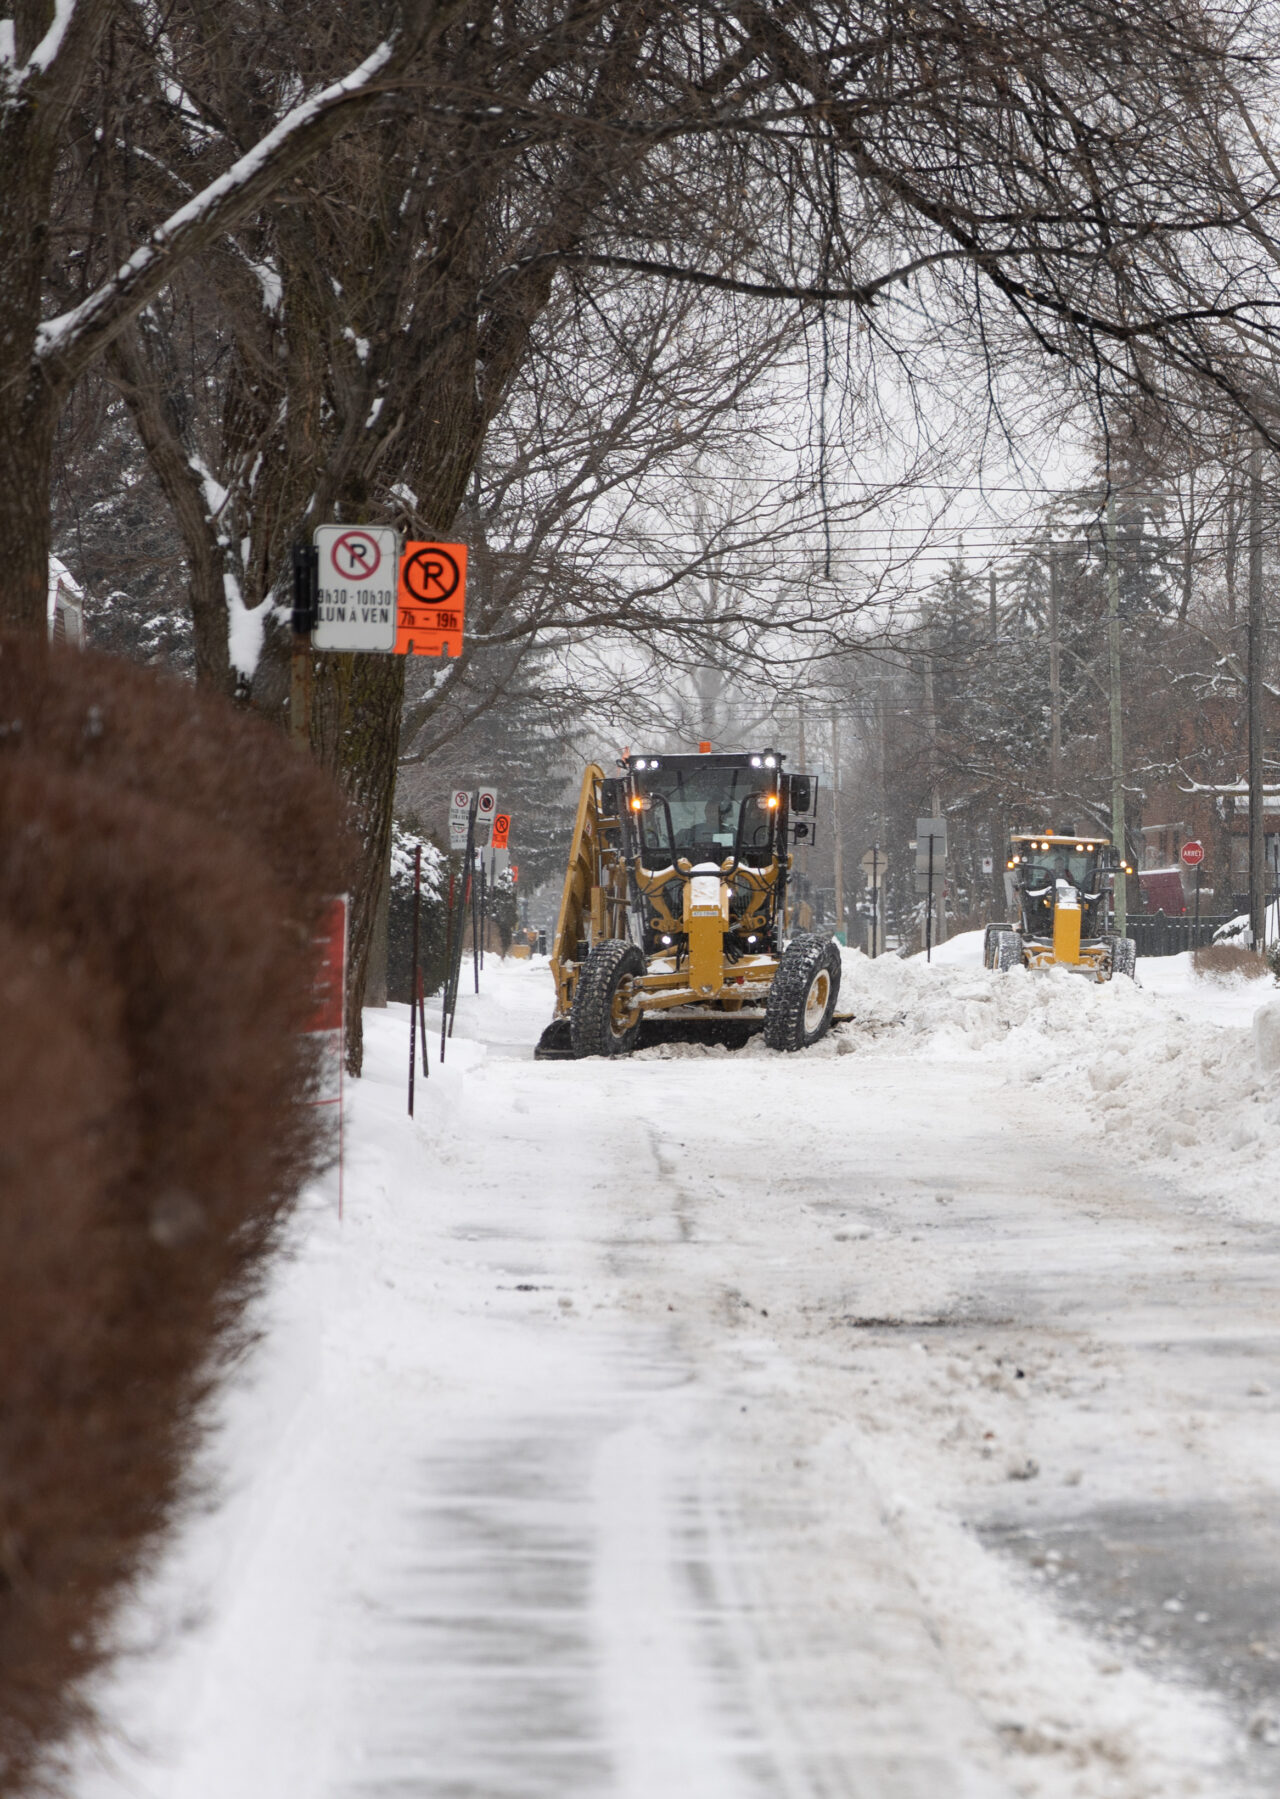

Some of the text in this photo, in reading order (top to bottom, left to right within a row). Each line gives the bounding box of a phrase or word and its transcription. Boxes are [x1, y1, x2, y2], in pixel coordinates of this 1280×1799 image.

[357, 589, 392, 606] 10h30
[318, 606, 346, 622] LUN
[361, 607, 389, 623] VEN
[401, 610, 415, 626] 7h
[437, 612, 458, 628] 19h
